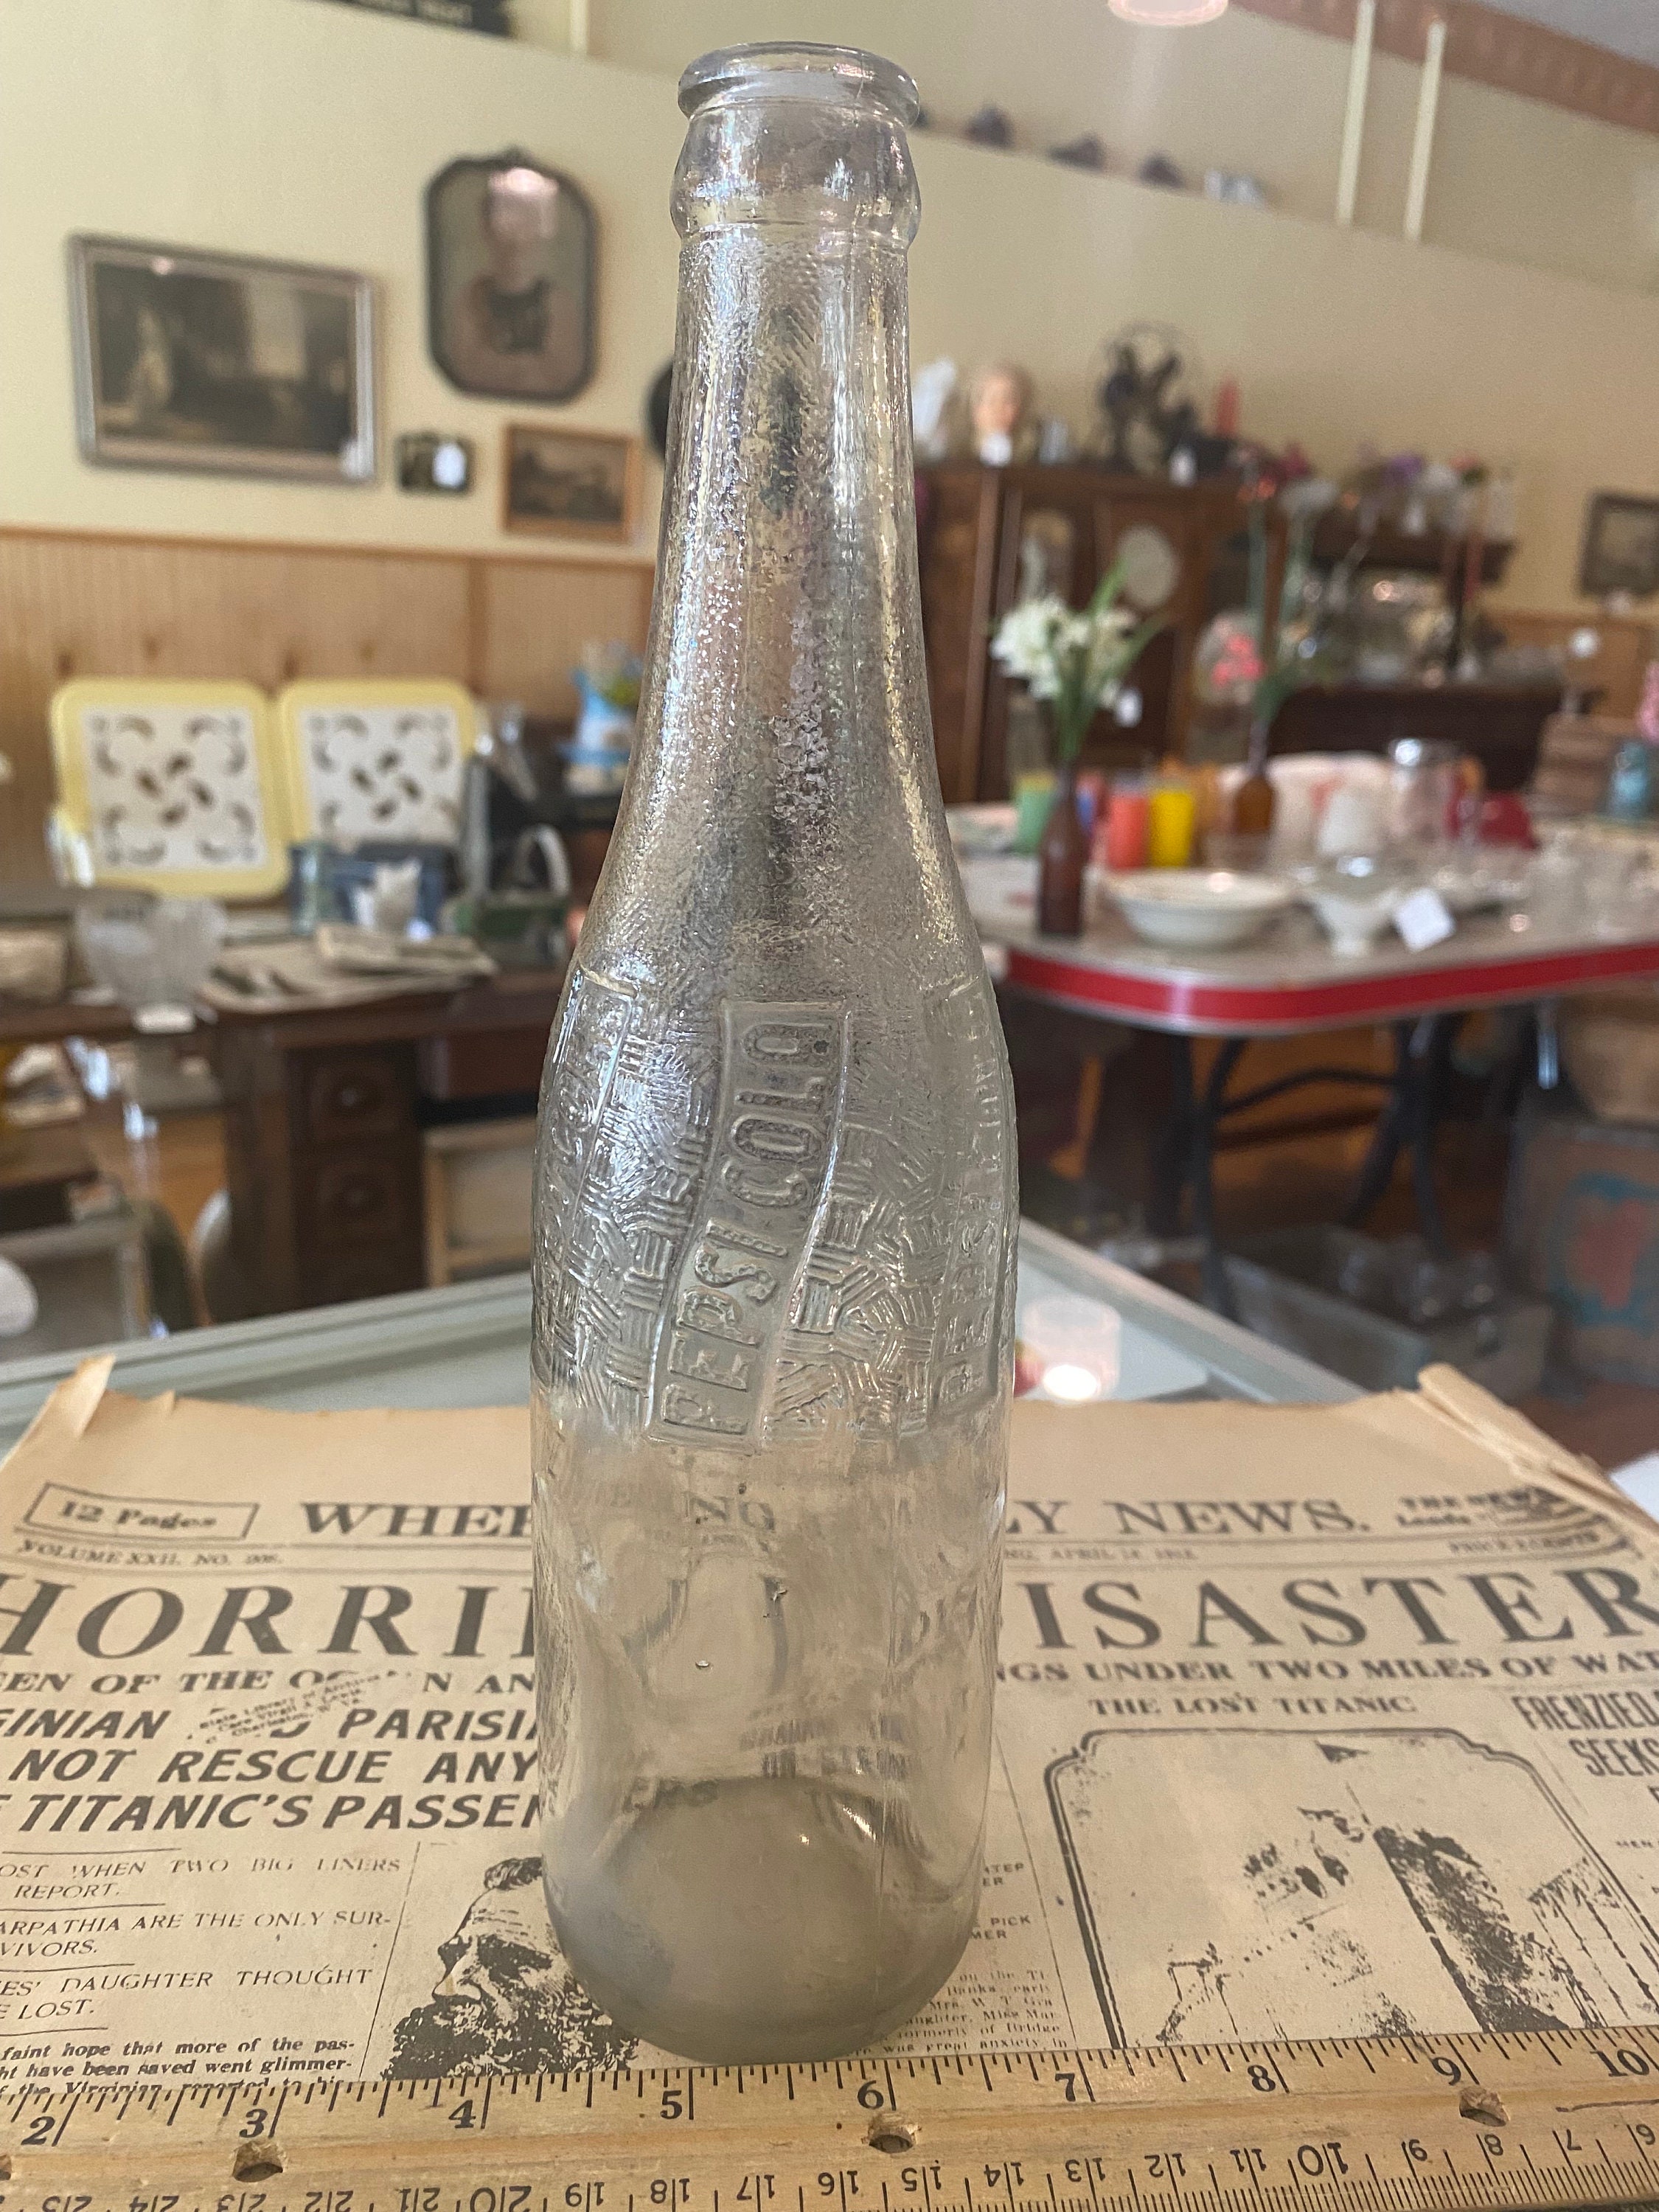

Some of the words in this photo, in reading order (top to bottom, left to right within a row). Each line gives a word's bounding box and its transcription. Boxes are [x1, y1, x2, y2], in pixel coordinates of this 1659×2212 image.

[720, 1021, 830, 1208] COLA
[660, 1218, 787, 1435] PEPSI
[59, 1500, 104, 1523] 12
[115, 1509, 217, 1530] Pages
[1104, 1498, 1370, 1534] NEWS.
[18, 1539, 121, 1564] VOLUME
[0, 1672, 73, 1692] EN
[91, 1674, 161, 1694] OF
[179, 1670, 274, 1693] THE
[1084, 1661, 1233, 1681] UNDER
[1249, 1659, 1349, 1680] TWO
[1361, 1658, 1492, 1678] MILES
[1500, 1656, 1557, 1677] OF
[1088, 1698, 1162, 1715] THE
[1173, 1697, 1257, 1714] LOST
[1273, 1697, 1417, 1715] TITANIC
[1512, 1691, 1659, 1731] FRENZIED
[7, 1749, 137, 1782] NOT
[158, 1749, 392, 1784] RESCUE
[422, 1751, 538, 1783] ANY
[18, 1793, 310, 1832] TITANIC'S
[73, 1861, 146, 1879] WHEN
[170, 1859, 229, 1874] TWO
[251, 1858, 293, 1872] BIG
[317, 1858, 400, 1872] LINERS
[14, 1882, 120, 1899] REPORT.
[131, 1914, 184, 1930] ARE
[195, 1912, 245, 1928] THE
[254, 1911, 324, 1927] ONLY
[333, 1910, 392, 1925] SUR-
[990, 1915, 1032, 1926] PICK
[0, 1939, 97, 1957] VIVORS.
[60, 1972, 213, 1993] DAUGHTER
[237, 1968, 373, 1986] THOUGHT
[18, 1999, 95, 2020] LOST.
[1, 2045, 52, 2061] faint
[62, 2042, 111, 2059] hope
[123, 2041, 163, 2056] that
[175, 2042, 227, 2054] more
[237, 2037, 261, 2053] of
[272, 2037, 304, 2052] the
[314, 2039, 355, 2053] pas-
[883, 2044, 915, 2054] was
[26, 2063, 74, 2078] have
[83, 2059, 130, 2076] been
[138, 2059, 197, 2076] saved
[206, 2059, 252, 2073] went
[260, 2056, 352, 2075] glimmer-
[21, 2115, 56, 2146] 2
[238, 2108, 268, 2138] 3
[448, 2099, 476, 2129] 4
[660, 2090, 683, 2119] 5
[857, 2080, 884, 2110] 6
[1054, 2072, 1077, 2102] 7
[1247, 2065, 1276, 2093] 8
[1431, 2056, 1461, 2086] 9
[1591, 2048, 1650, 2077] 10
[1484, 2134, 1504, 2156] 8
[1565, 2129, 1582, 2152] 7
[1634, 2123, 1658, 2146] 6
[1230, 2148, 1267, 2173] 11
[1297, 2141, 1349, 2177] 10
[1408, 2139, 1427, 2162] 9
[984, 2161, 1025, 2187] 14
[1065, 2157, 1106, 2183] 13
[1144, 2152, 1187, 2177] 12
[737, 2174, 776, 2201] 17
[818, 2170, 860, 2196] 16
[901, 2165, 942, 2192] 15
[394, 2187, 441, 2212] 21
[470, 2185, 532, 2212] 20
[565, 2181, 605, 2208] 19
[650, 2178, 691, 2205] 18
